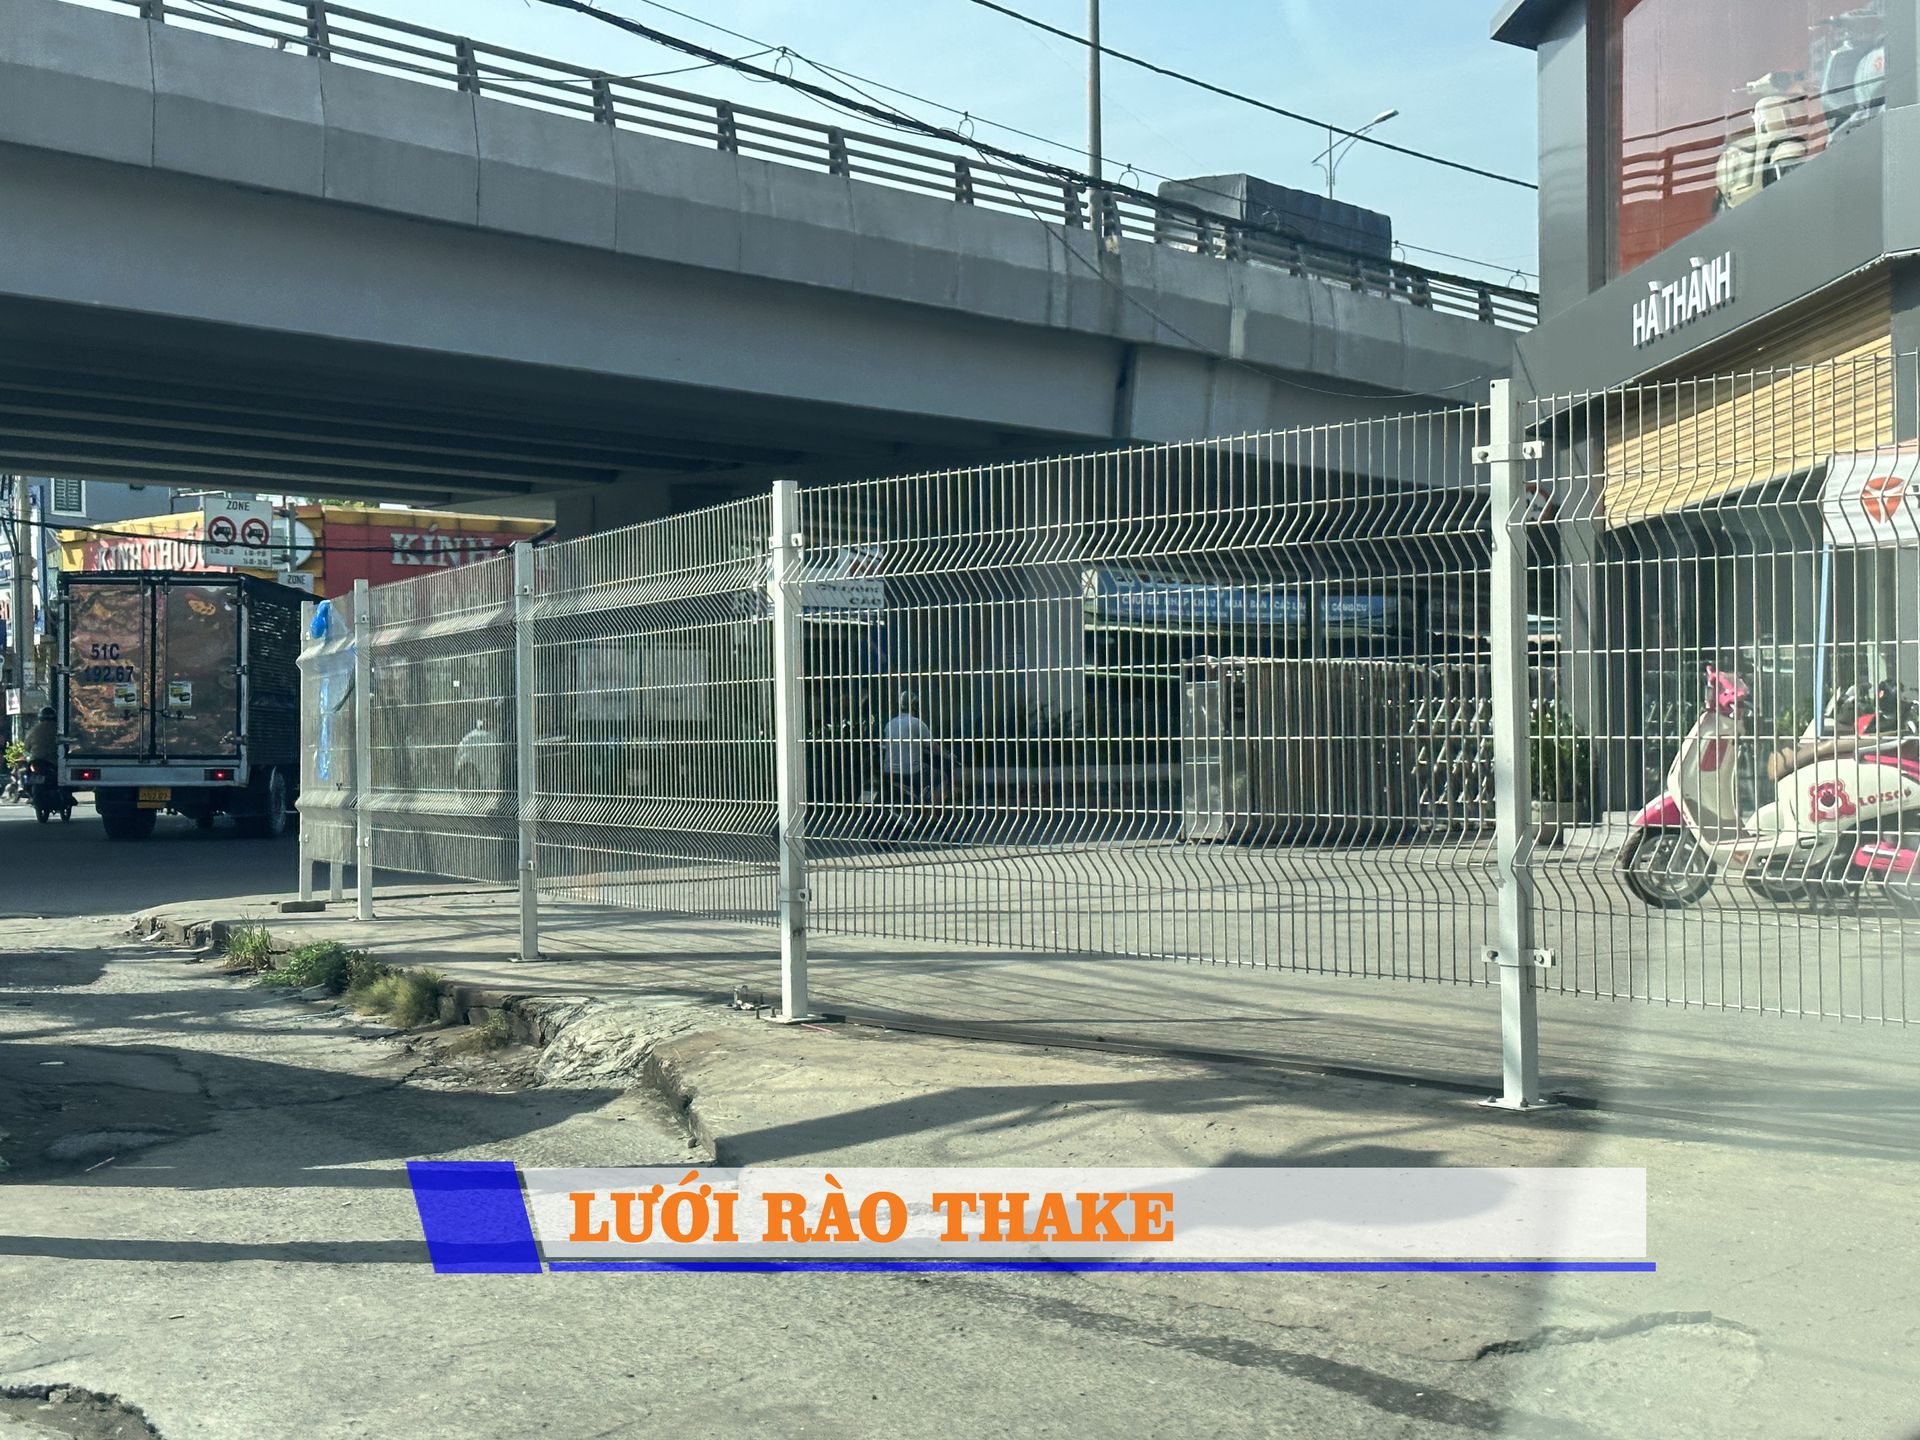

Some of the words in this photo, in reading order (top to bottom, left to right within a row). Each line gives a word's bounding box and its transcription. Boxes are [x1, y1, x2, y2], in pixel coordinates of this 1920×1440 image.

[1633, 281, 1662, 347] HÀ
[1661, 251, 1731, 331] THÀNH
[226, 501, 251, 511] ZONE
[390, 523, 495, 567] KÍNH
[287, 574, 306, 585] ZONE
[91, 643, 120, 660] 51C
